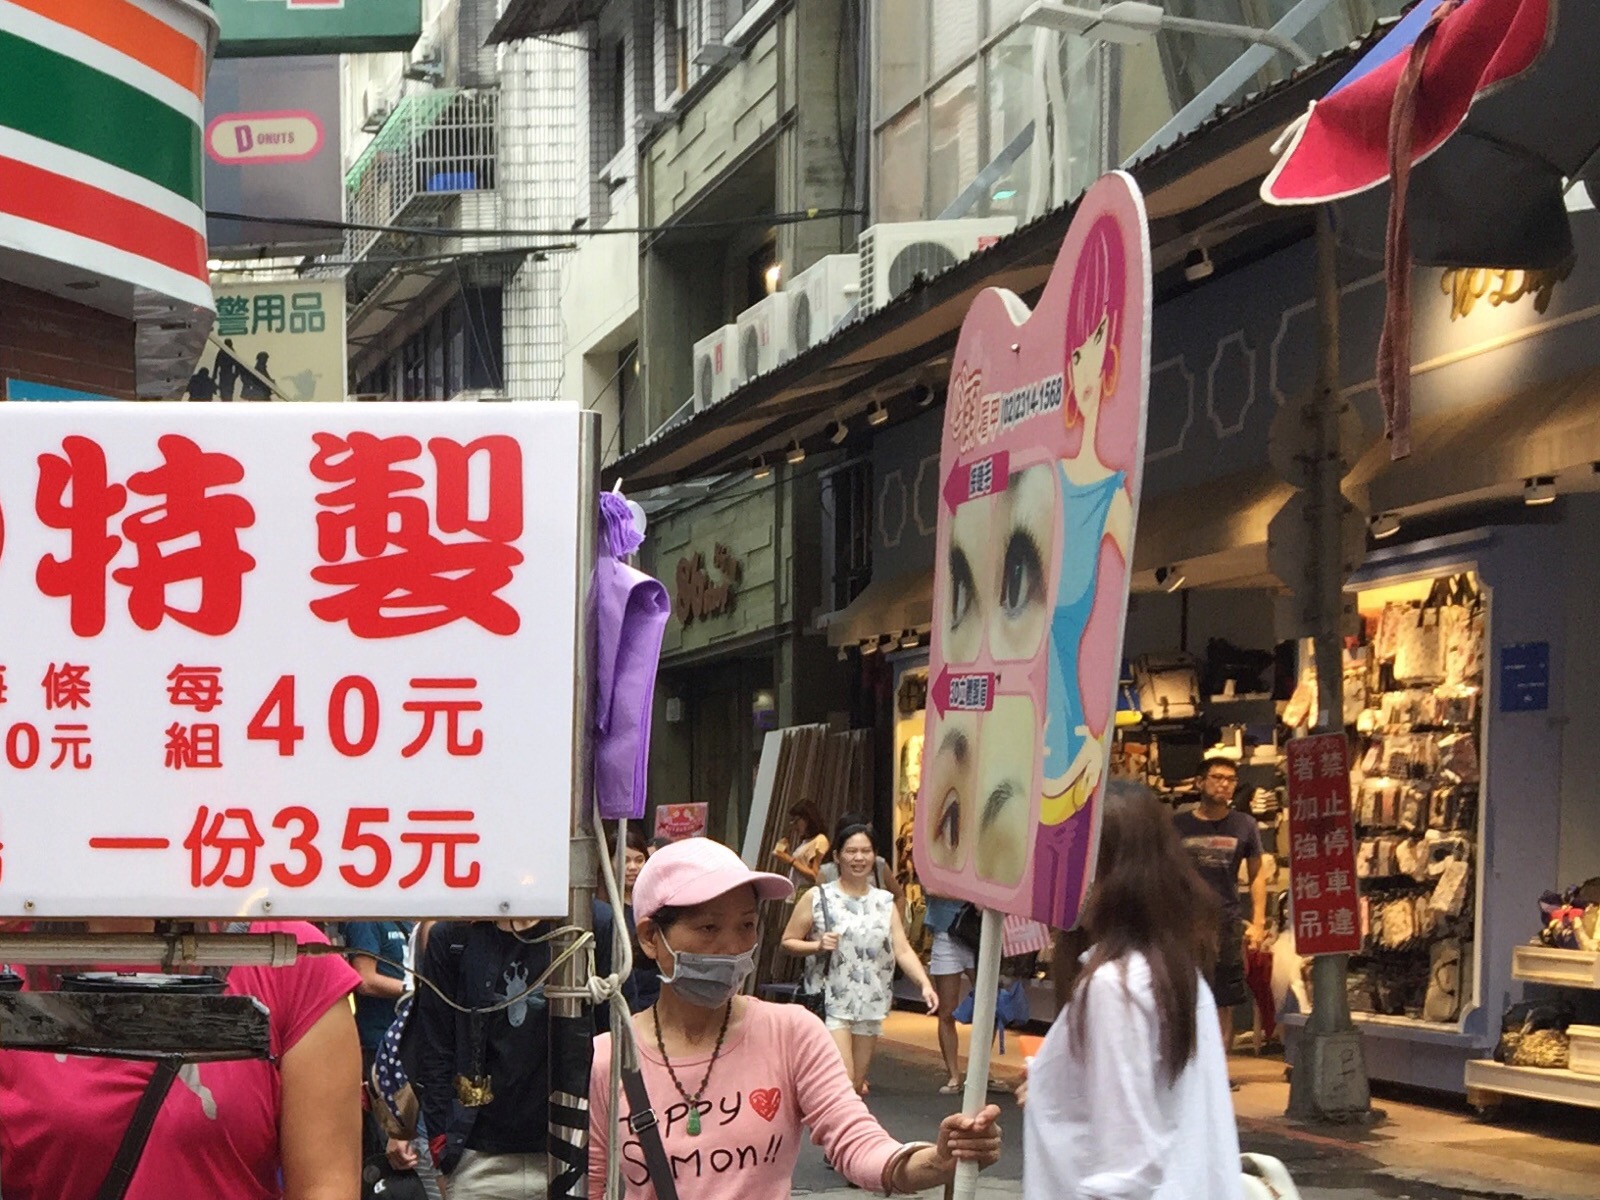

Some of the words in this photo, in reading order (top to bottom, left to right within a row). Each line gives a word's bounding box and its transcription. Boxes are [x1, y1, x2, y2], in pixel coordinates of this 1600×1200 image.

[214, 291, 326, 337] 警用品
[35, 431, 524, 640] 特製
[165, 663, 224, 771] 每組
[247, 674, 483, 759] 40元
[89, 804, 480, 890] 一份35元
[1292, 755, 1323, 939] 者加強拖吊
[1318, 751, 1355, 937] 禁止停車違
